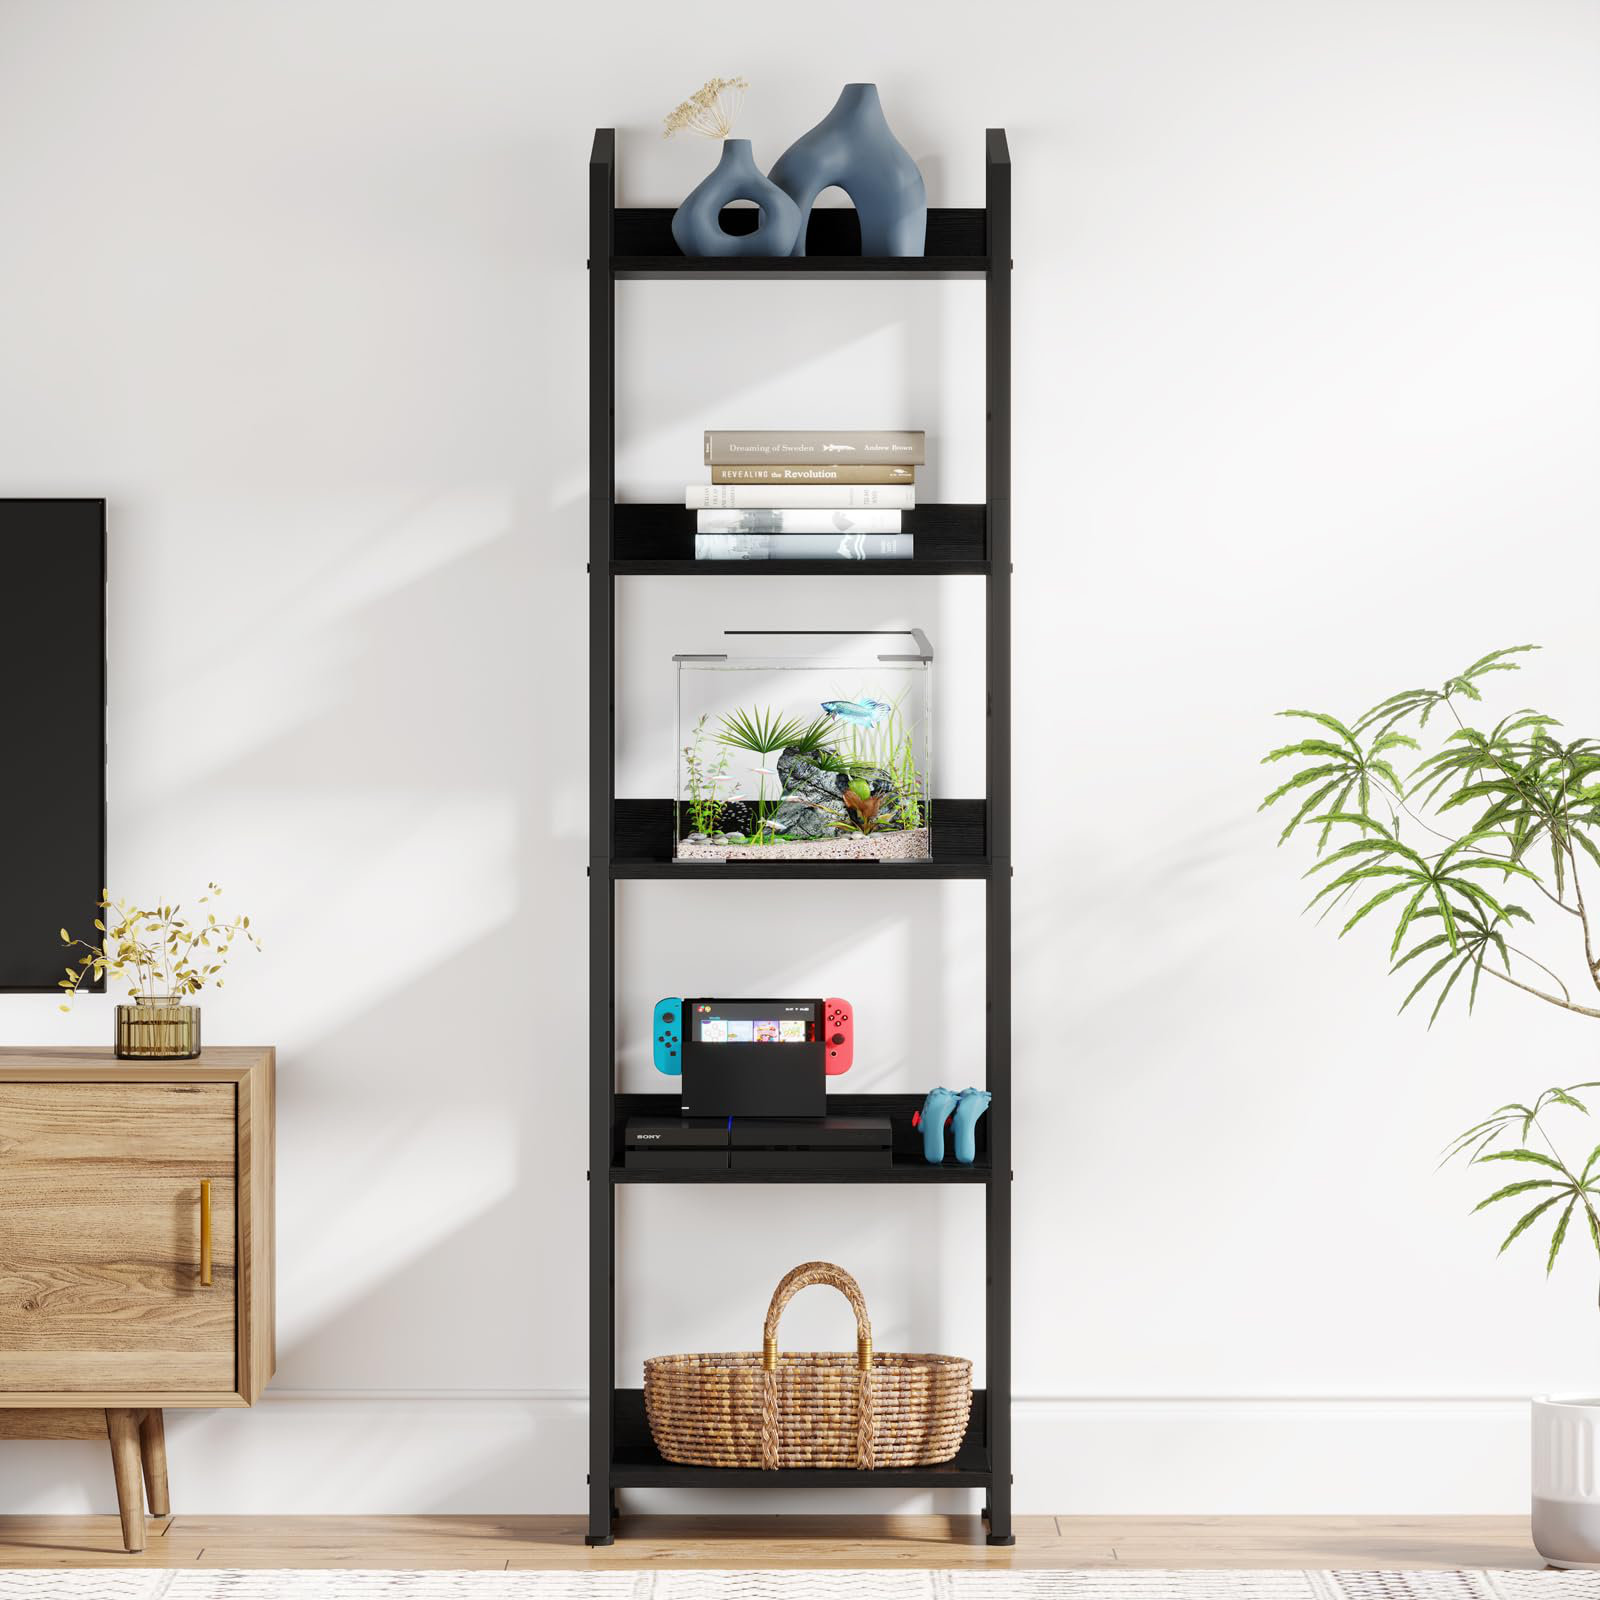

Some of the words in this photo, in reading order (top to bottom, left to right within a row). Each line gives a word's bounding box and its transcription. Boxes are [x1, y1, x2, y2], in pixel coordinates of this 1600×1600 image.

[729, 444, 770, 454] Dreaming
[771, 444, 781, 452] of
[782, 444, 815, 452] Sweden
[722, 470, 768, 478] REVEALING
[784, 469, 837, 478] Revolution
